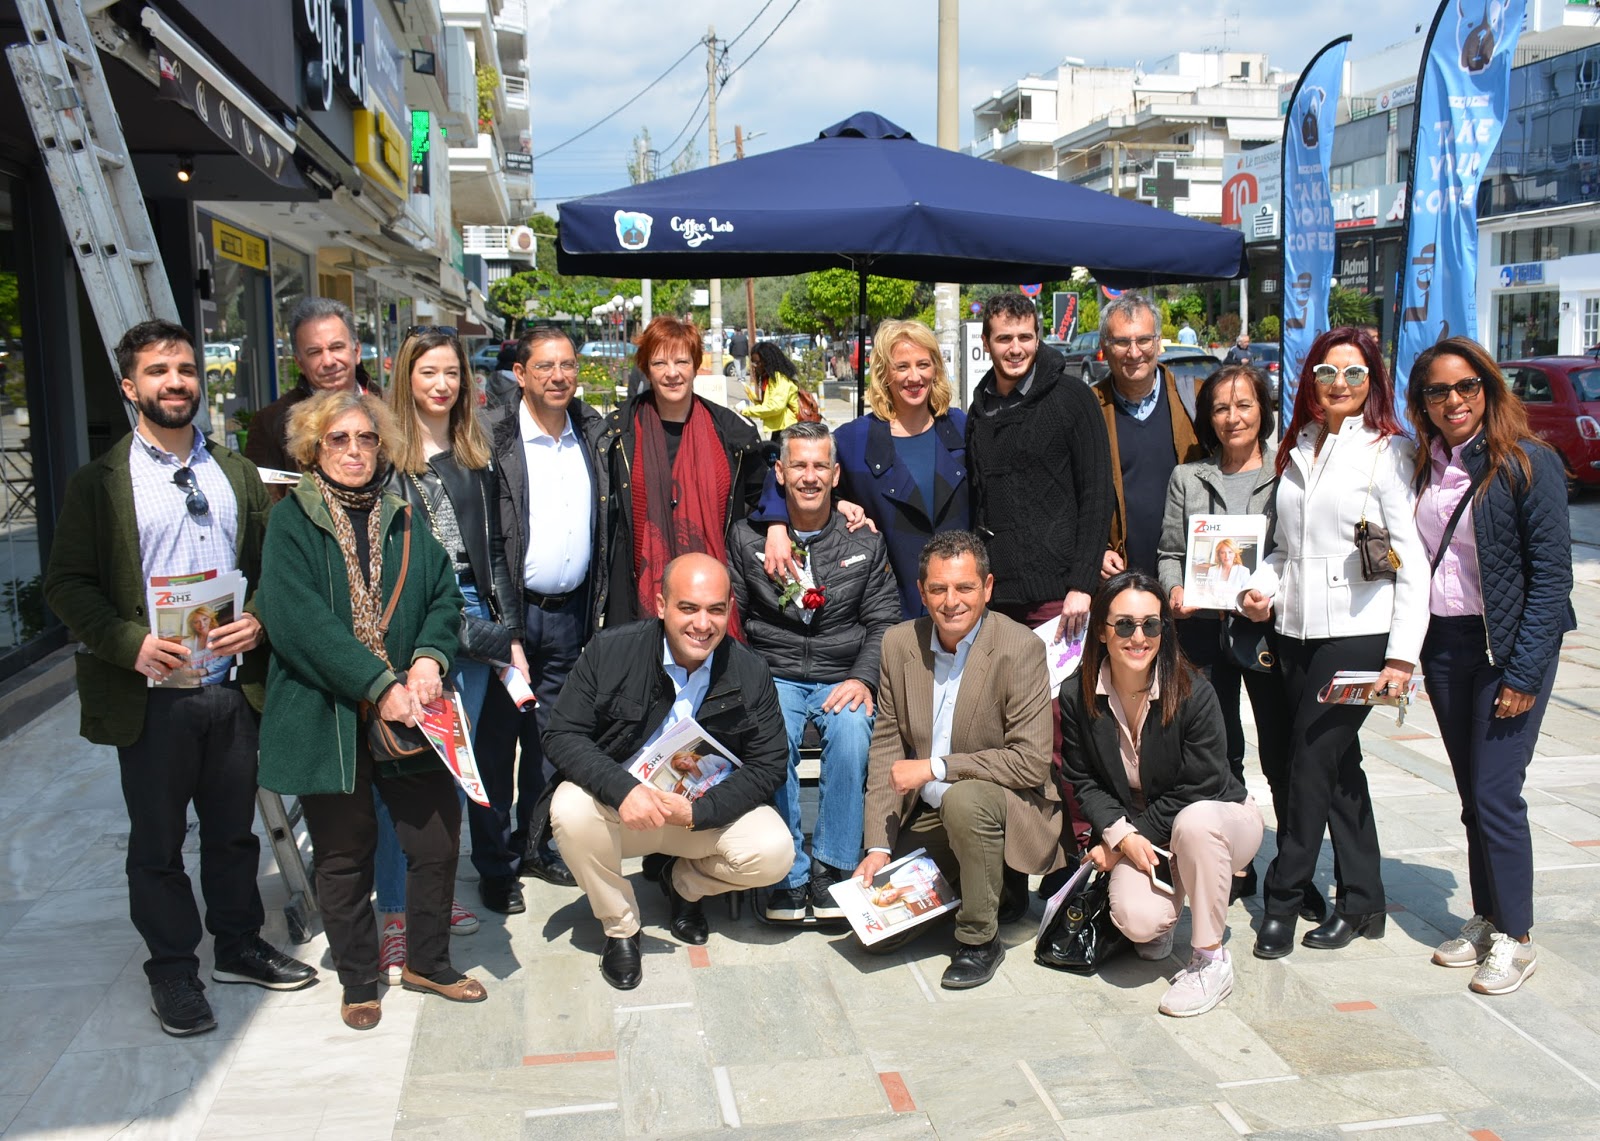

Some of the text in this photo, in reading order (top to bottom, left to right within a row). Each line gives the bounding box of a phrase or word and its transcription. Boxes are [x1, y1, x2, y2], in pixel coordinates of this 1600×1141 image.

[670, 216, 734, 239] Coffee Lab
[1194, 520, 1222, 533] ΖΩΗΣ
[154, 591, 192, 607] ΖΩΗΣ
[637, 752, 665, 780] ΖΩΗΣ
[861, 910, 884, 935] ΖΩΗΣ
